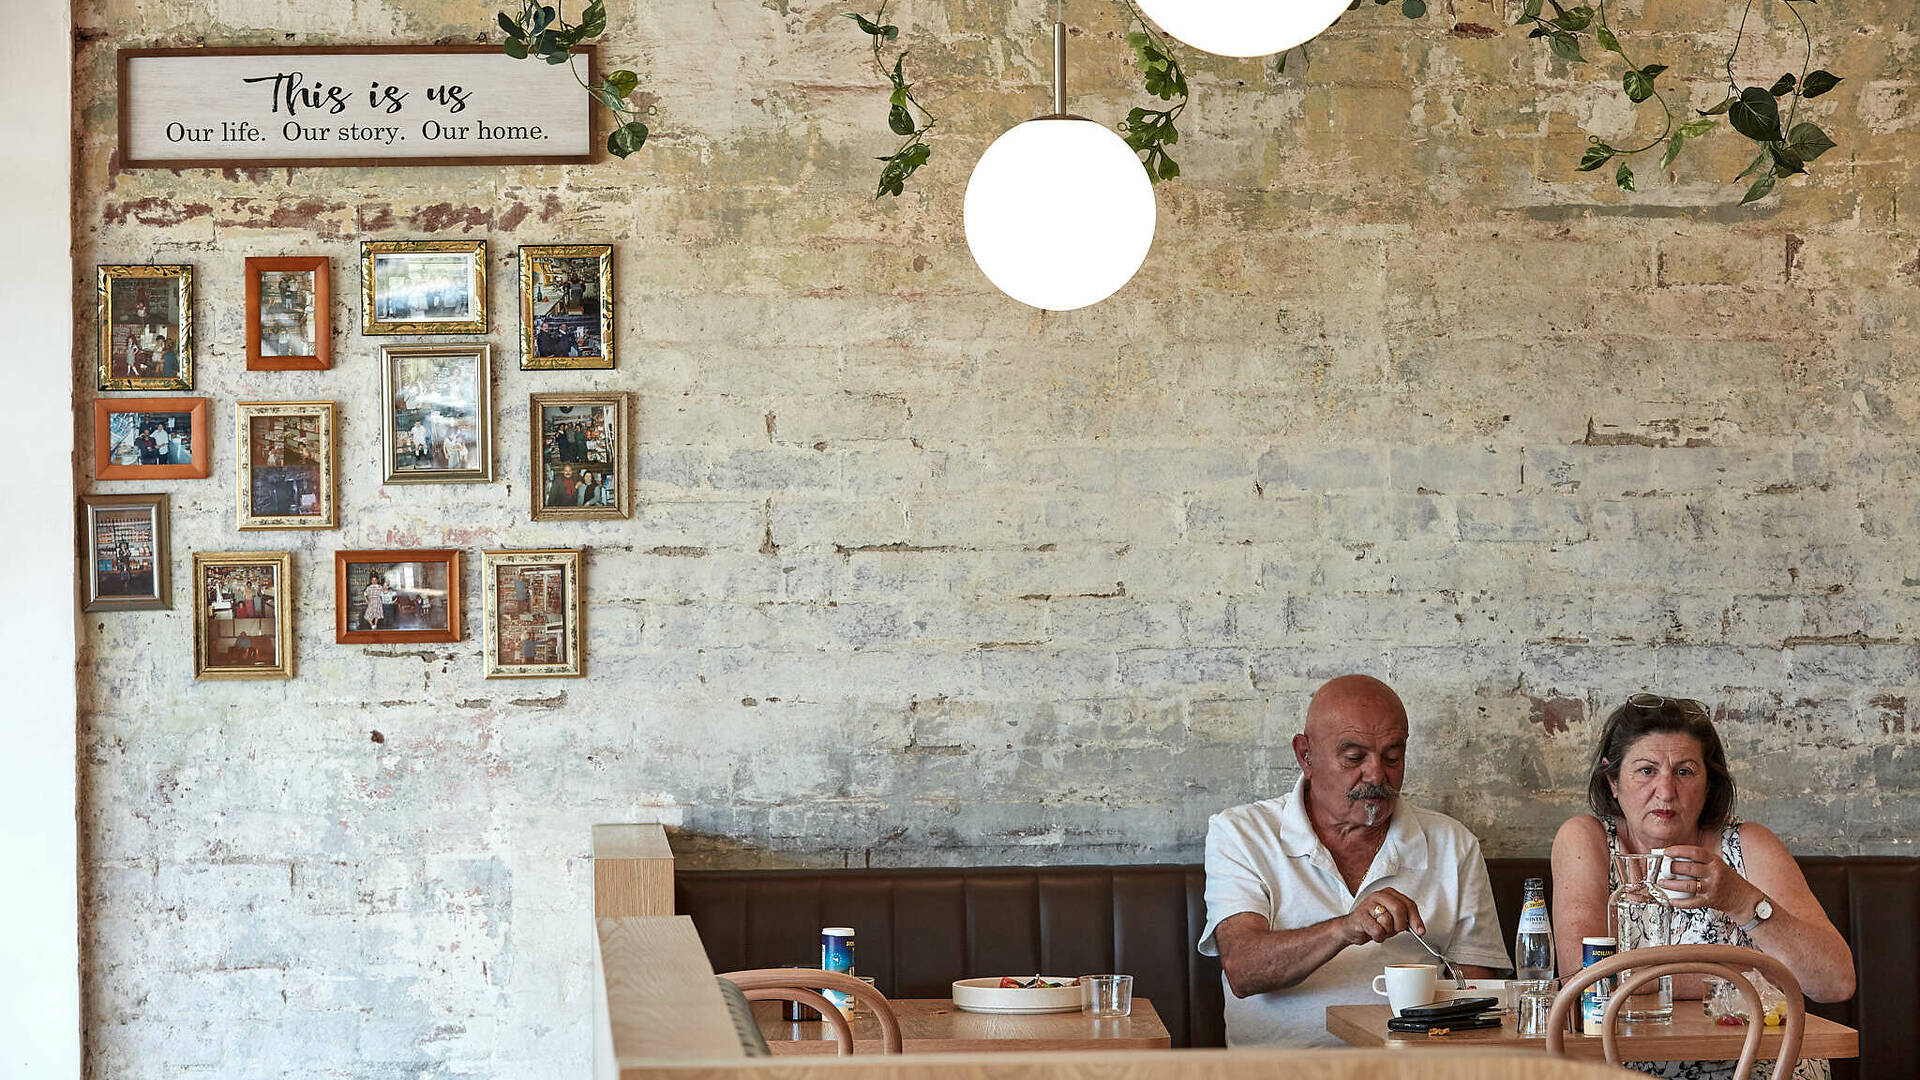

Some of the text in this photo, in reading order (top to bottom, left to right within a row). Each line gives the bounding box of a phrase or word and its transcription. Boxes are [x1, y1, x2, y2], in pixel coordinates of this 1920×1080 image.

[242, 71, 473, 117] This is us
[166, 120, 549, 146] Our life. Our story. Our home.
